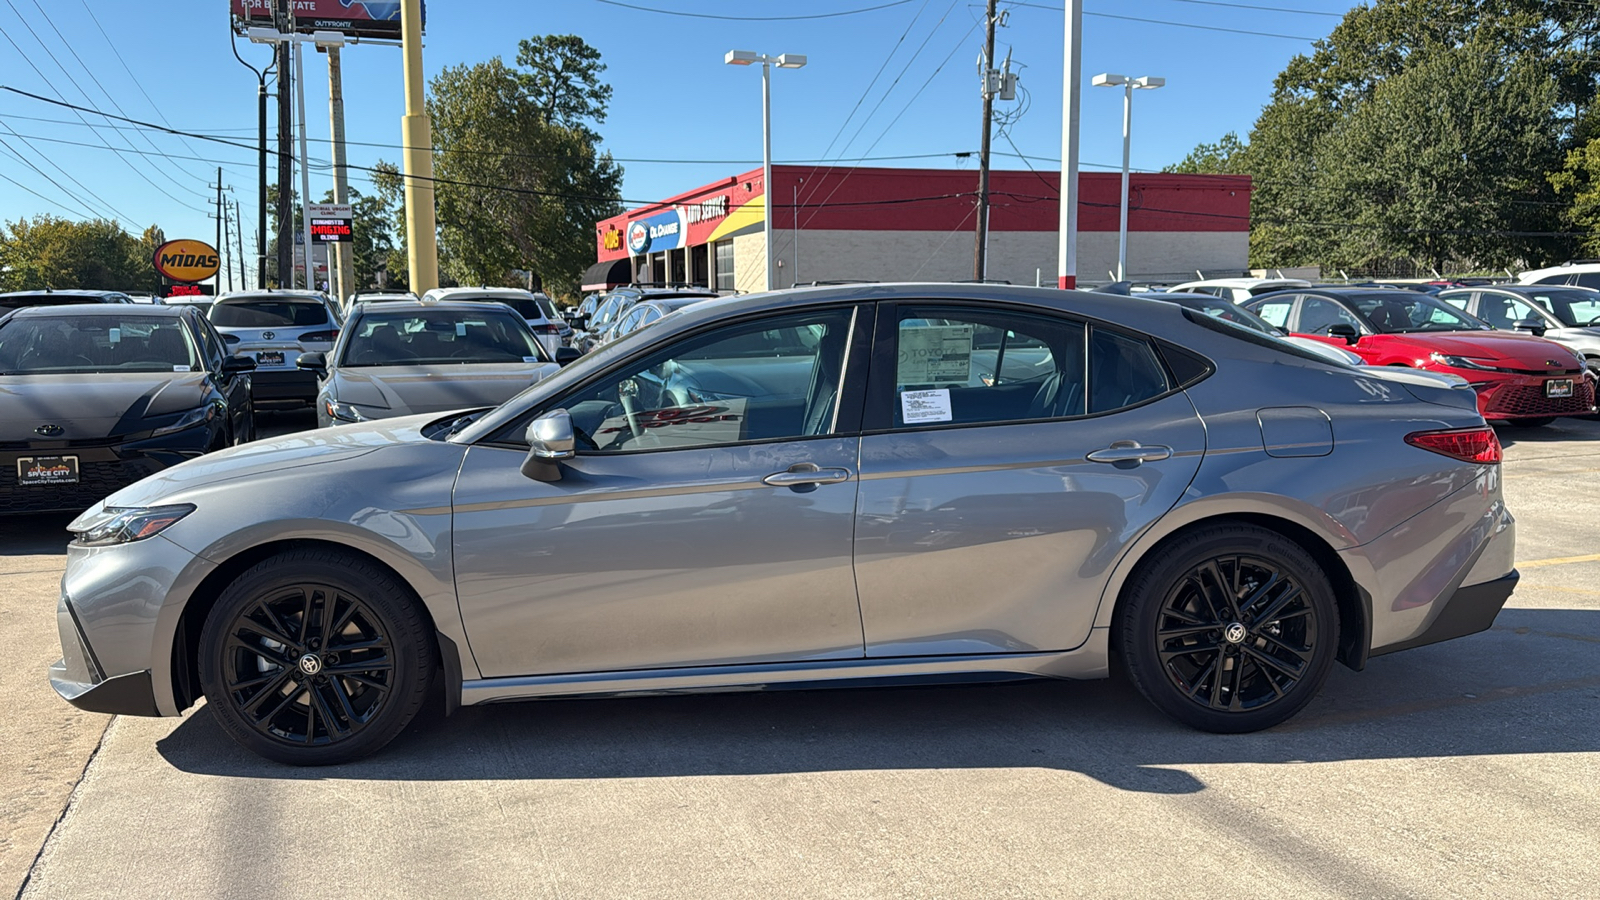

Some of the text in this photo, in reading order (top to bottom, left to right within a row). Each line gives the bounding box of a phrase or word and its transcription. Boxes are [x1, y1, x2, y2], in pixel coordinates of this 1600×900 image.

[310, 225, 351, 235] IMAGING
[160, 253, 219, 268] MIDAS
[27, 469, 52, 478] SPACE
